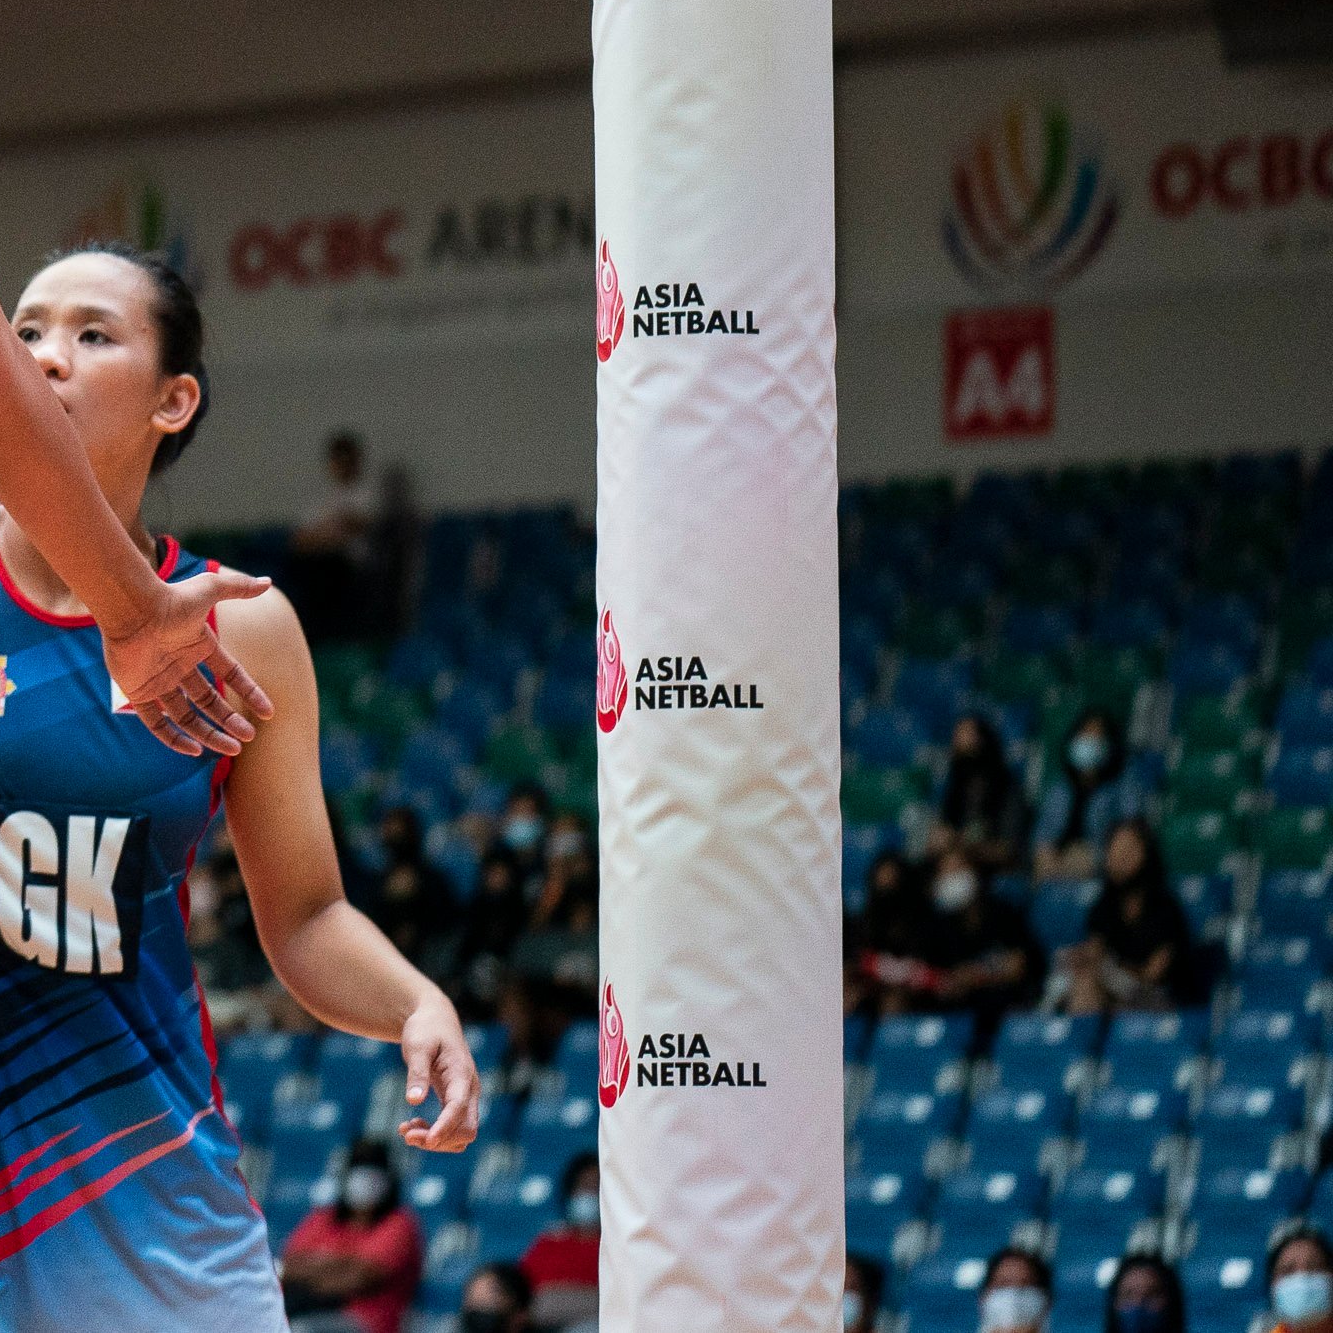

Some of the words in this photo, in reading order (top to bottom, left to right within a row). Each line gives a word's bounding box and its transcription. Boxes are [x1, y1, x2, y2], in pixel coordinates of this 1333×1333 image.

[633, 282, 705, 311] ASIA
[633, 309, 760, 338] NETBALL
[635, 656, 708, 683] ASIA
[635, 683, 764, 711] NETBALL
[637, 1033, 711, 1059] ASIA
[637, 1061, 767, 1088] NETBALL
